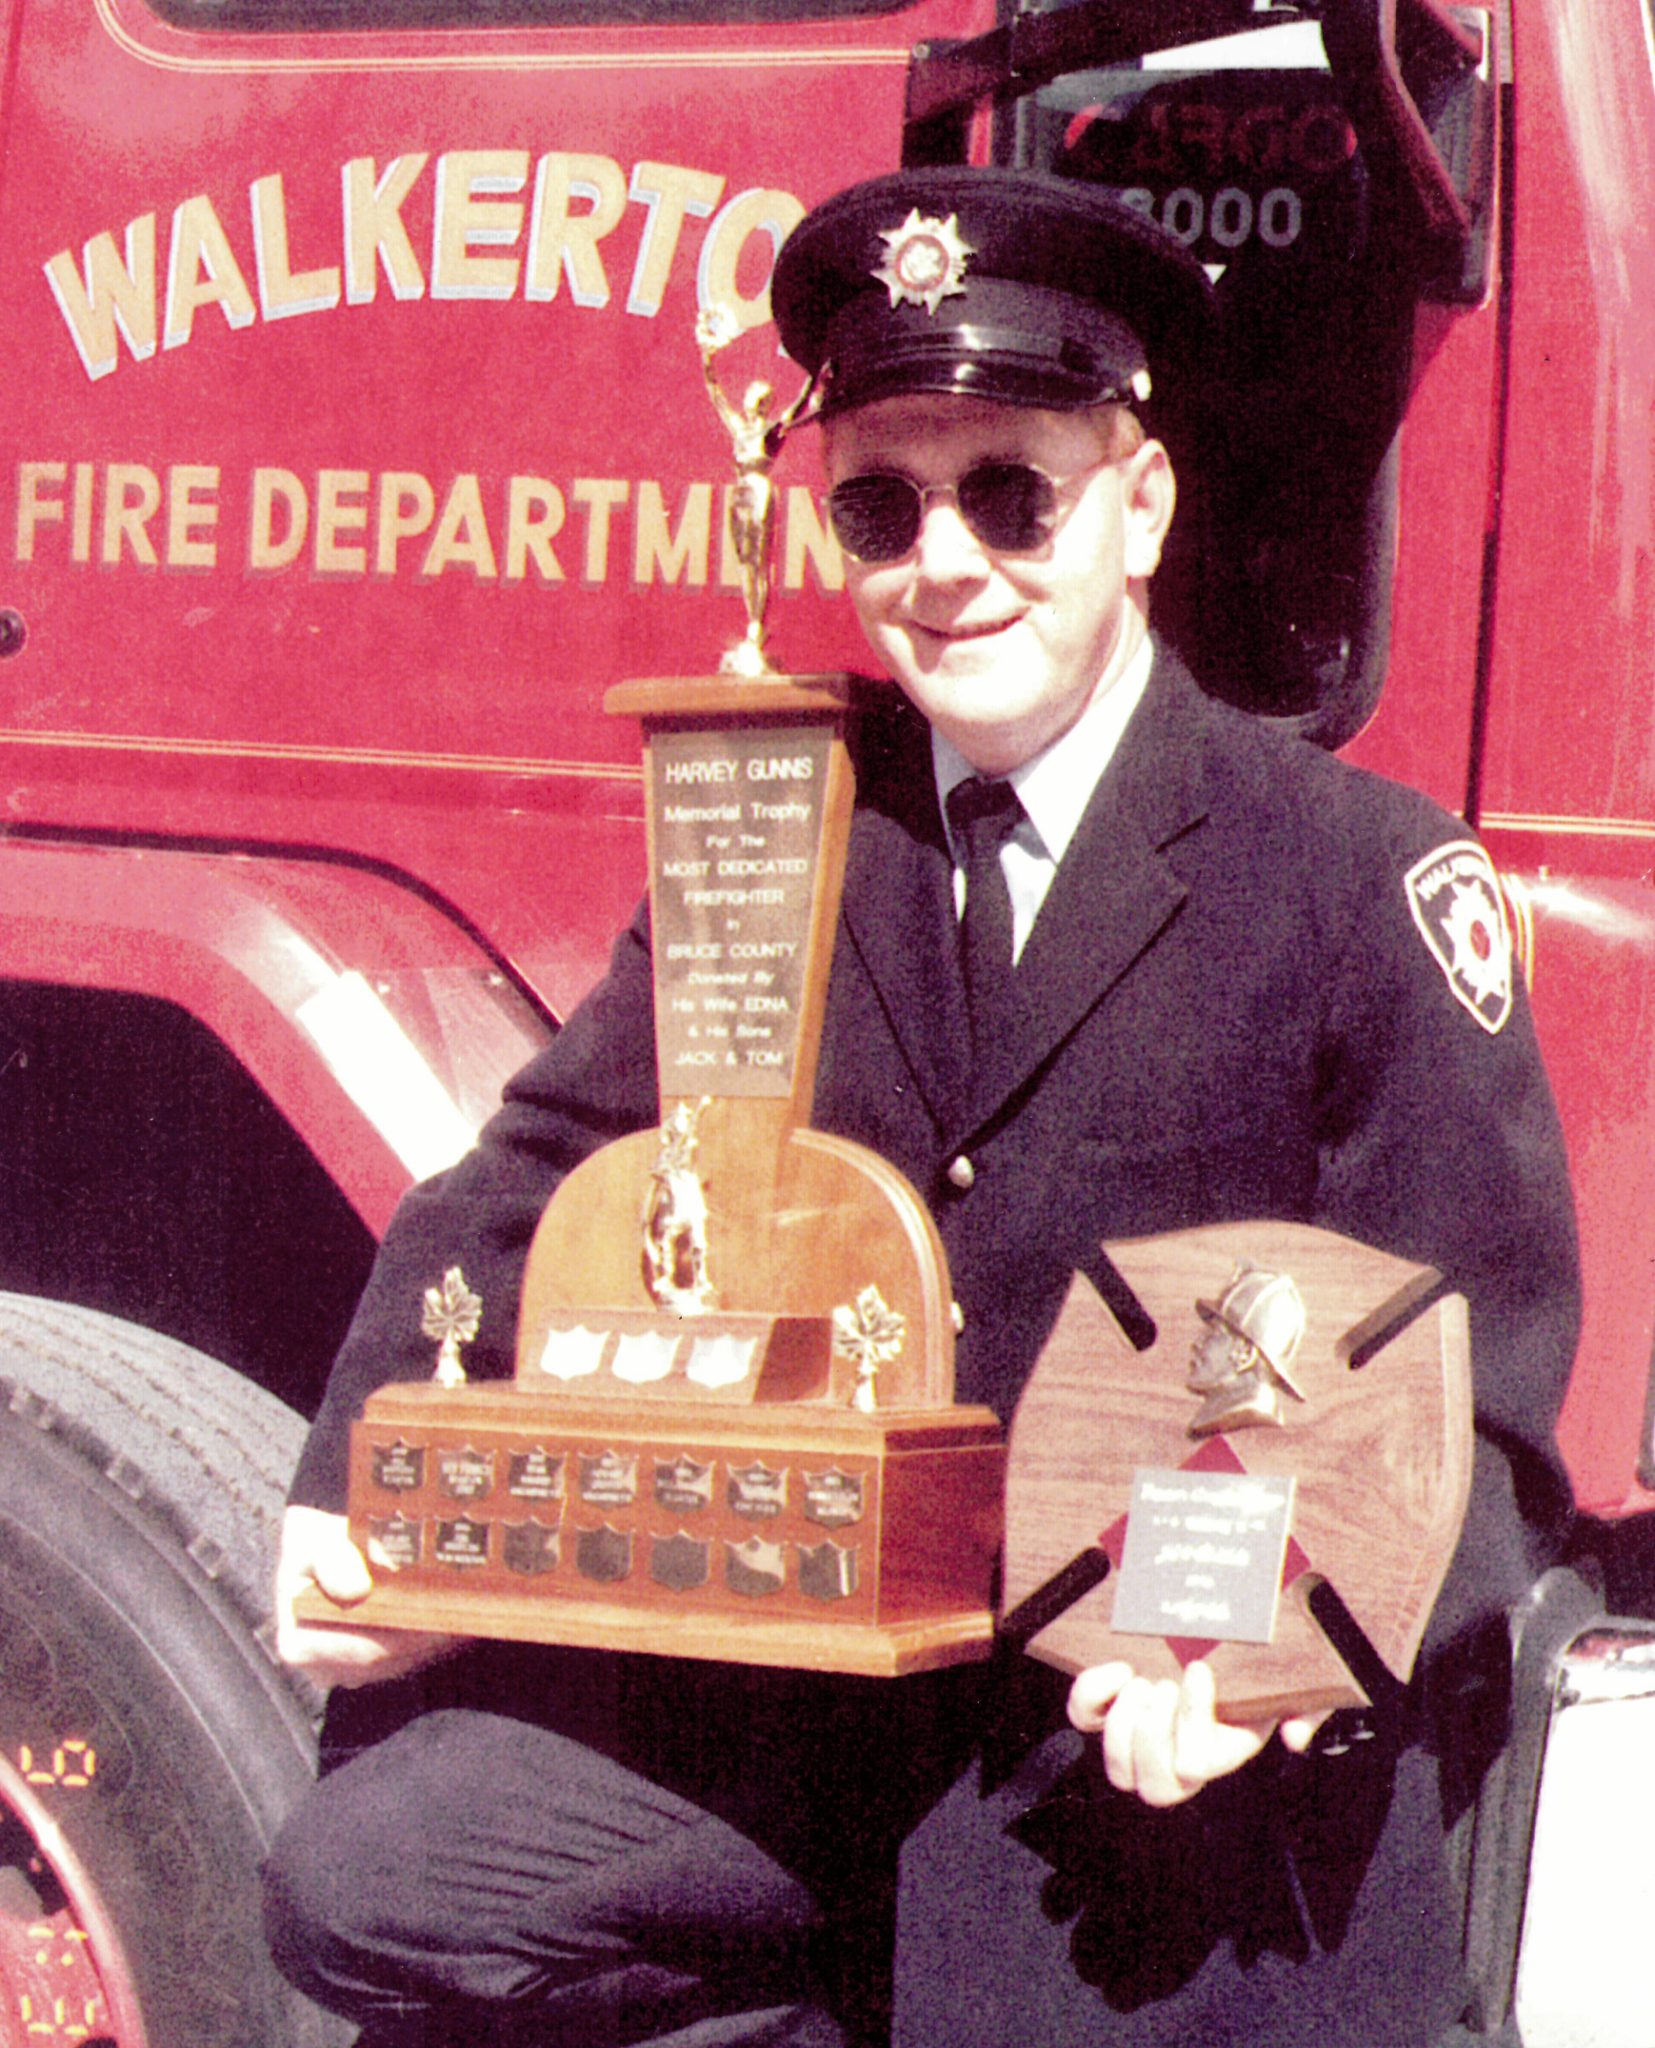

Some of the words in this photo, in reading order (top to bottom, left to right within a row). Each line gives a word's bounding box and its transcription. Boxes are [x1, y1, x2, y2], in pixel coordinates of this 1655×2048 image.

[43, 150, 808, 381] WALKERTO
[15, 462, 220, 571] FIRE
[248, 466, 846, 597] DEPARTMN
[665, 759, 739, 784] HARVEY
[664, 803, 741, 823] Memorial
[751, 801, 812, 823] Trophy
[663, 860, 710, 876] MOST
[717, 858, 807, 876] DEDICATED
[729, 941, 799, 958] COUNTY
[744, 997, 789, 1012] EDNA
[746, 1050, 784, 1065] TOM
